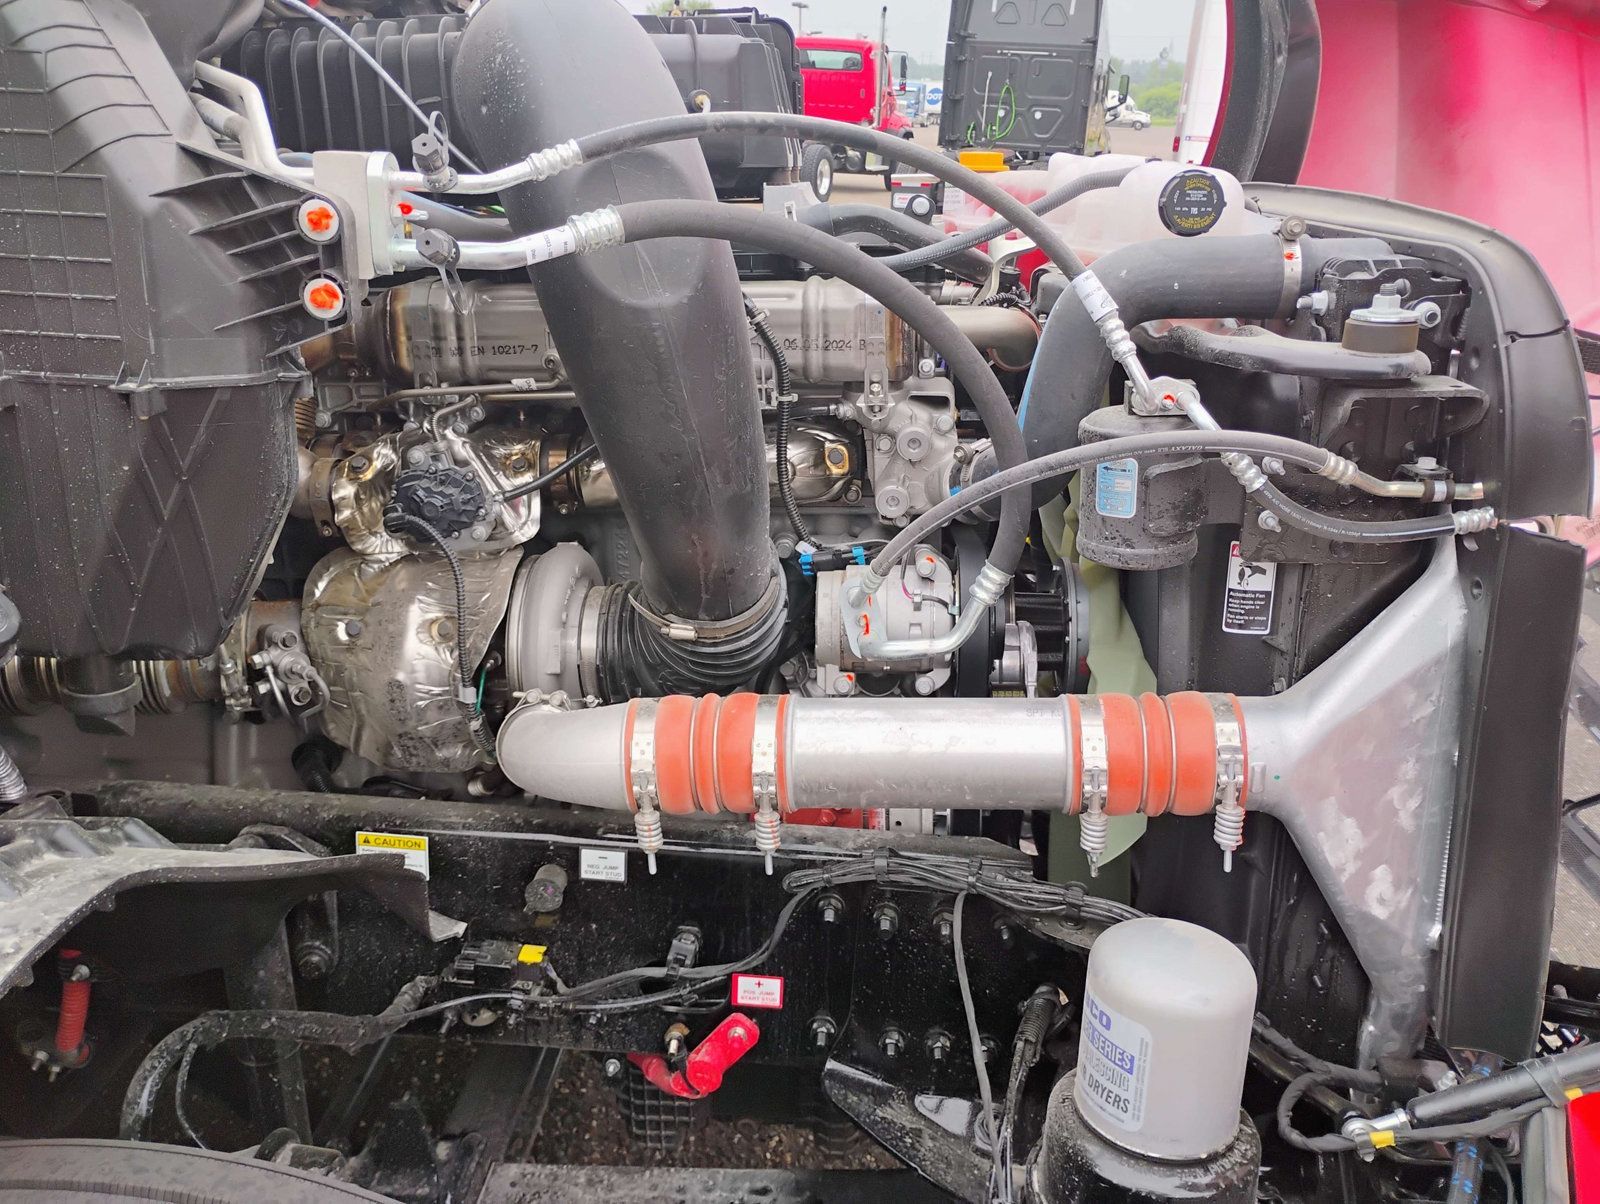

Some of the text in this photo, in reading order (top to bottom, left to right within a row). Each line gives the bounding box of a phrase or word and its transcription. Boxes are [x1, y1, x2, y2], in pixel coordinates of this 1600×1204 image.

[491, 344, 539, 356] 10217-7
[373, 837, 421, 848] CAUTION
[1093, 1031, 1132, 1069] SERIES
[1087, 1072, 1131, 1113] DRYERS
